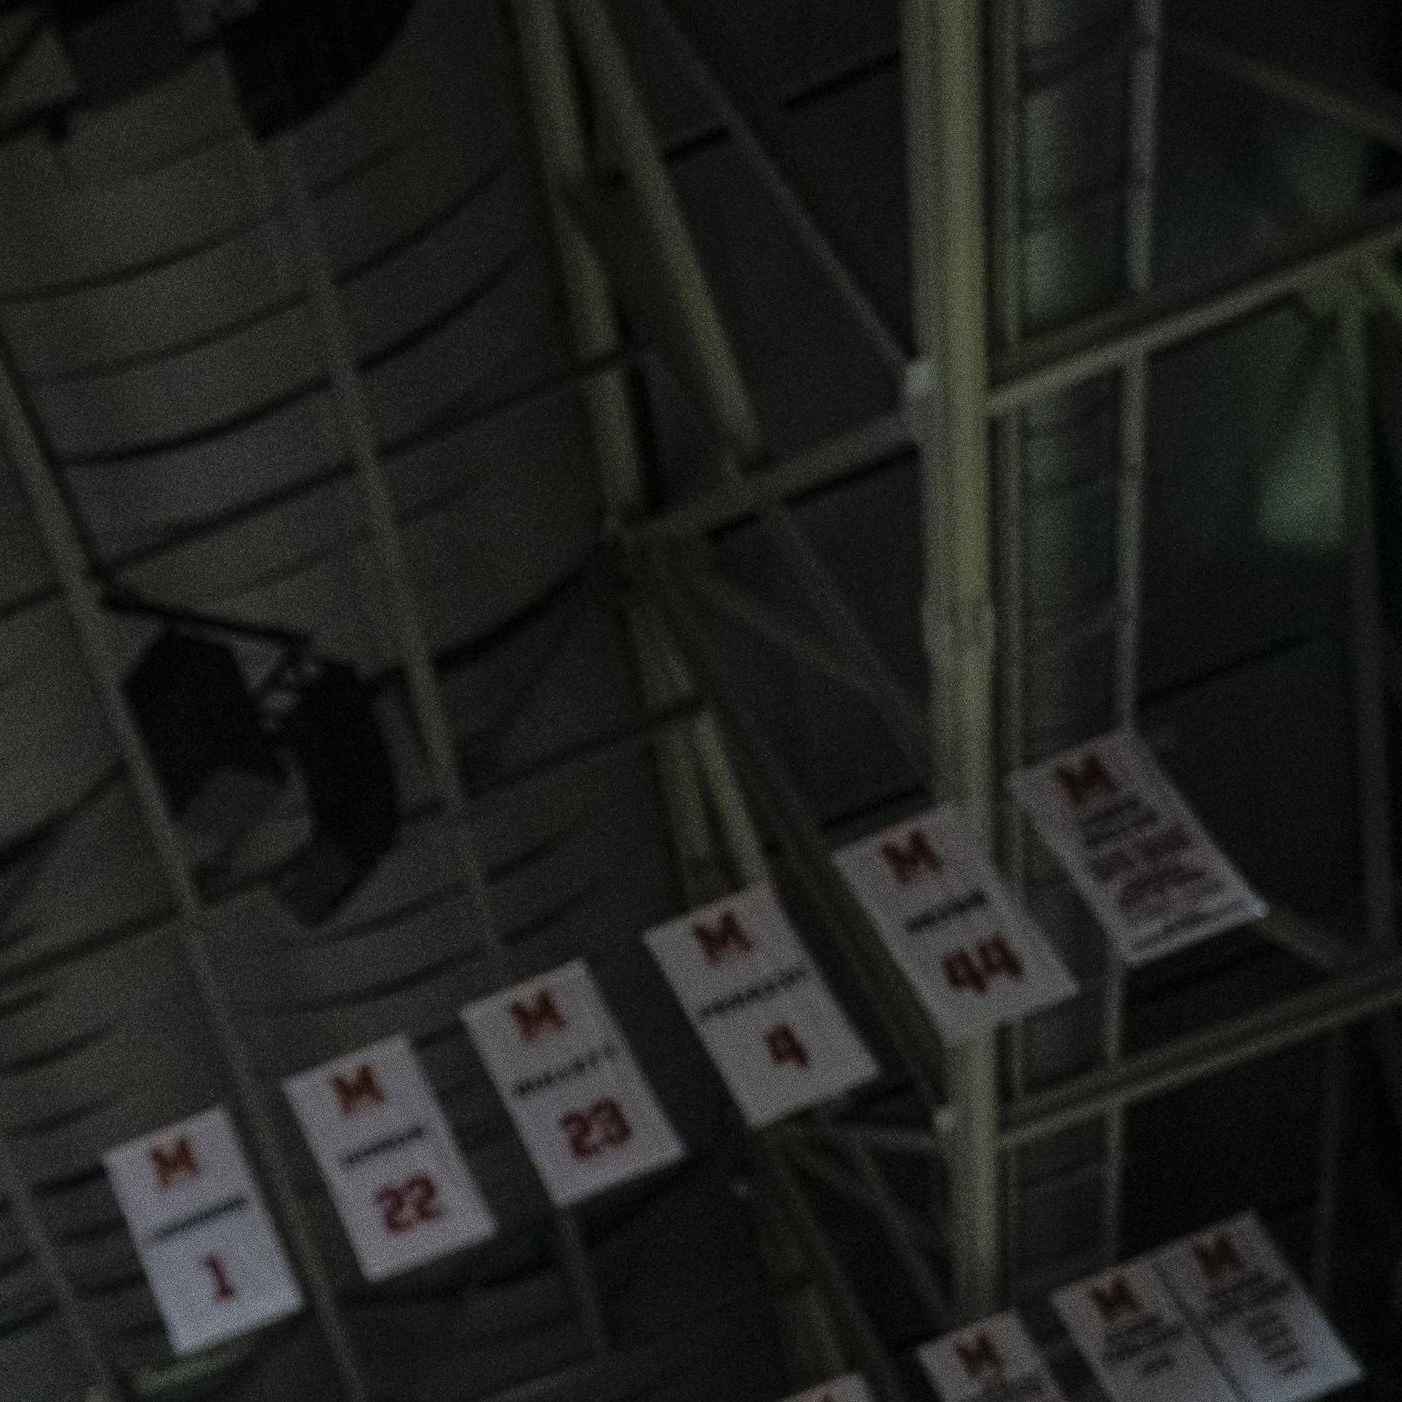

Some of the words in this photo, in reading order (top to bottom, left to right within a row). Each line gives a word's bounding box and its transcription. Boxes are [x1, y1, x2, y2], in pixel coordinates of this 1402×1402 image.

[941, 932, 1025, 996] 44
[558, 1098, 633, 1161] 23
[374, 1172, 443, 1234] 22
[204, 1254, 239, 1300] 1
